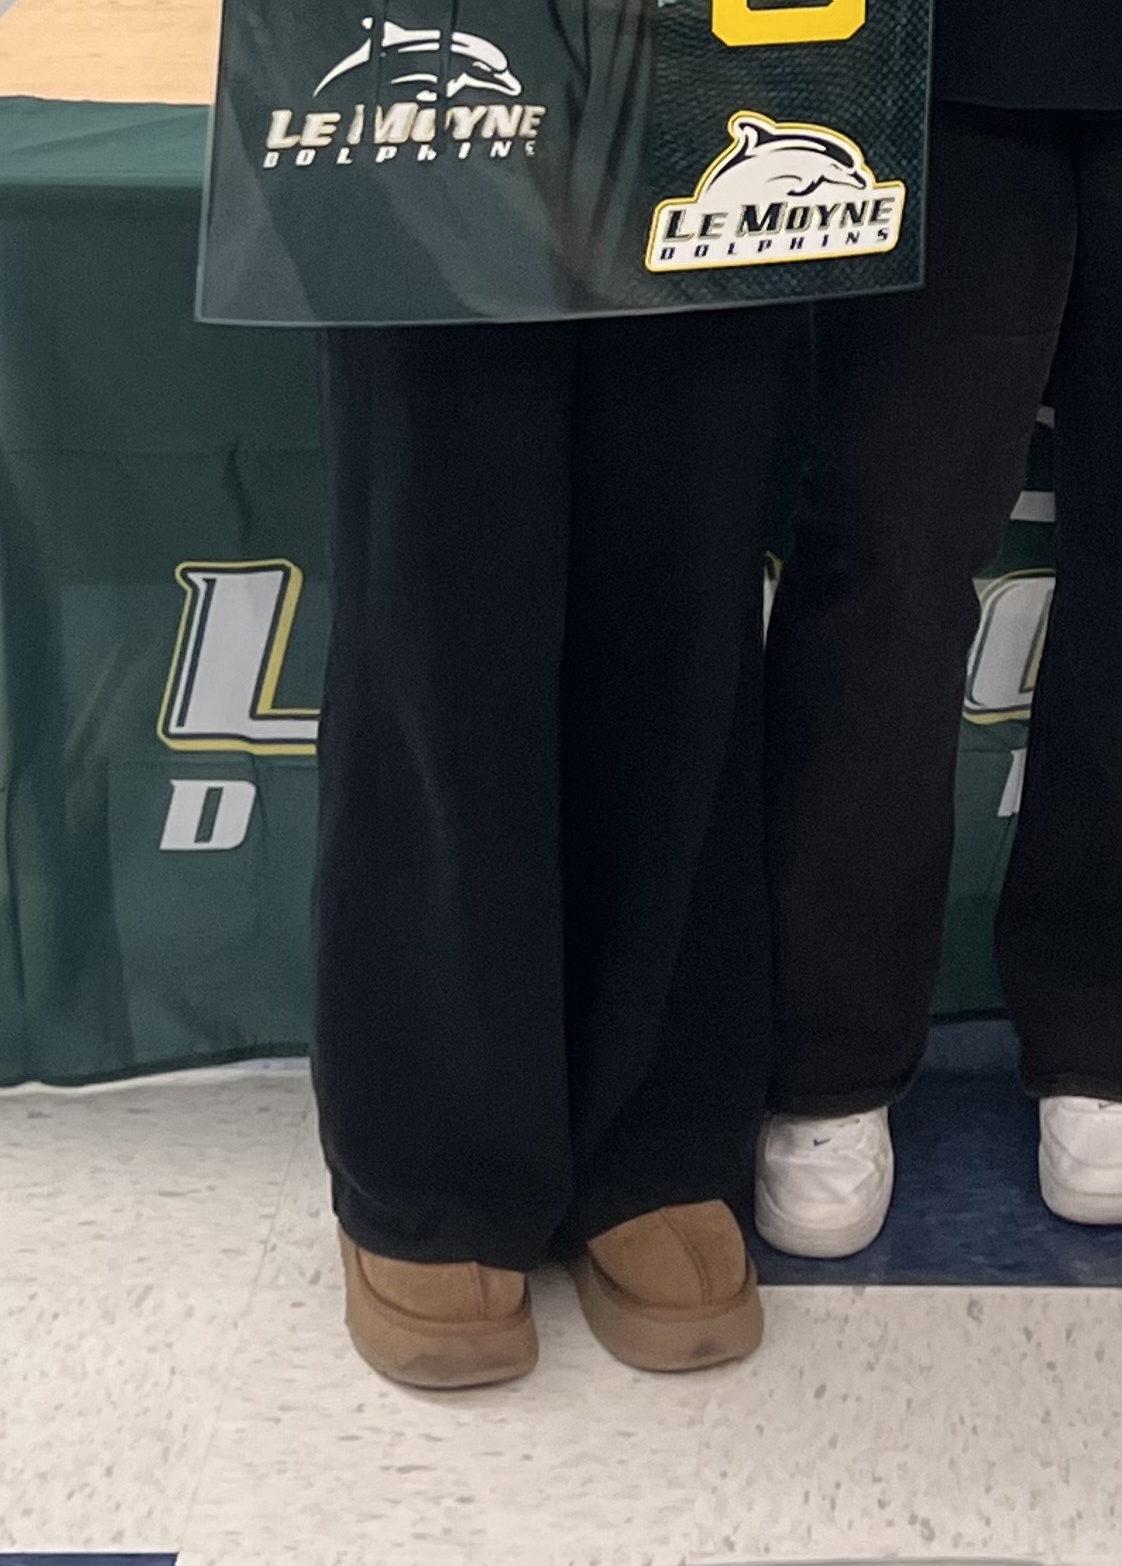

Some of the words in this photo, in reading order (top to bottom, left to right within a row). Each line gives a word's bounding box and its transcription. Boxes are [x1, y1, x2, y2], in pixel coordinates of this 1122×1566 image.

[267, 109, 341, 149] LE
[263, 140, 536, 168] DOLPHINS
[663, 209, 728, 243] LE
[736, 197, 895, 238] MOYNE
[659, 227, 890, 262] DOLPHINS
[157, 558, 321, 755] L
